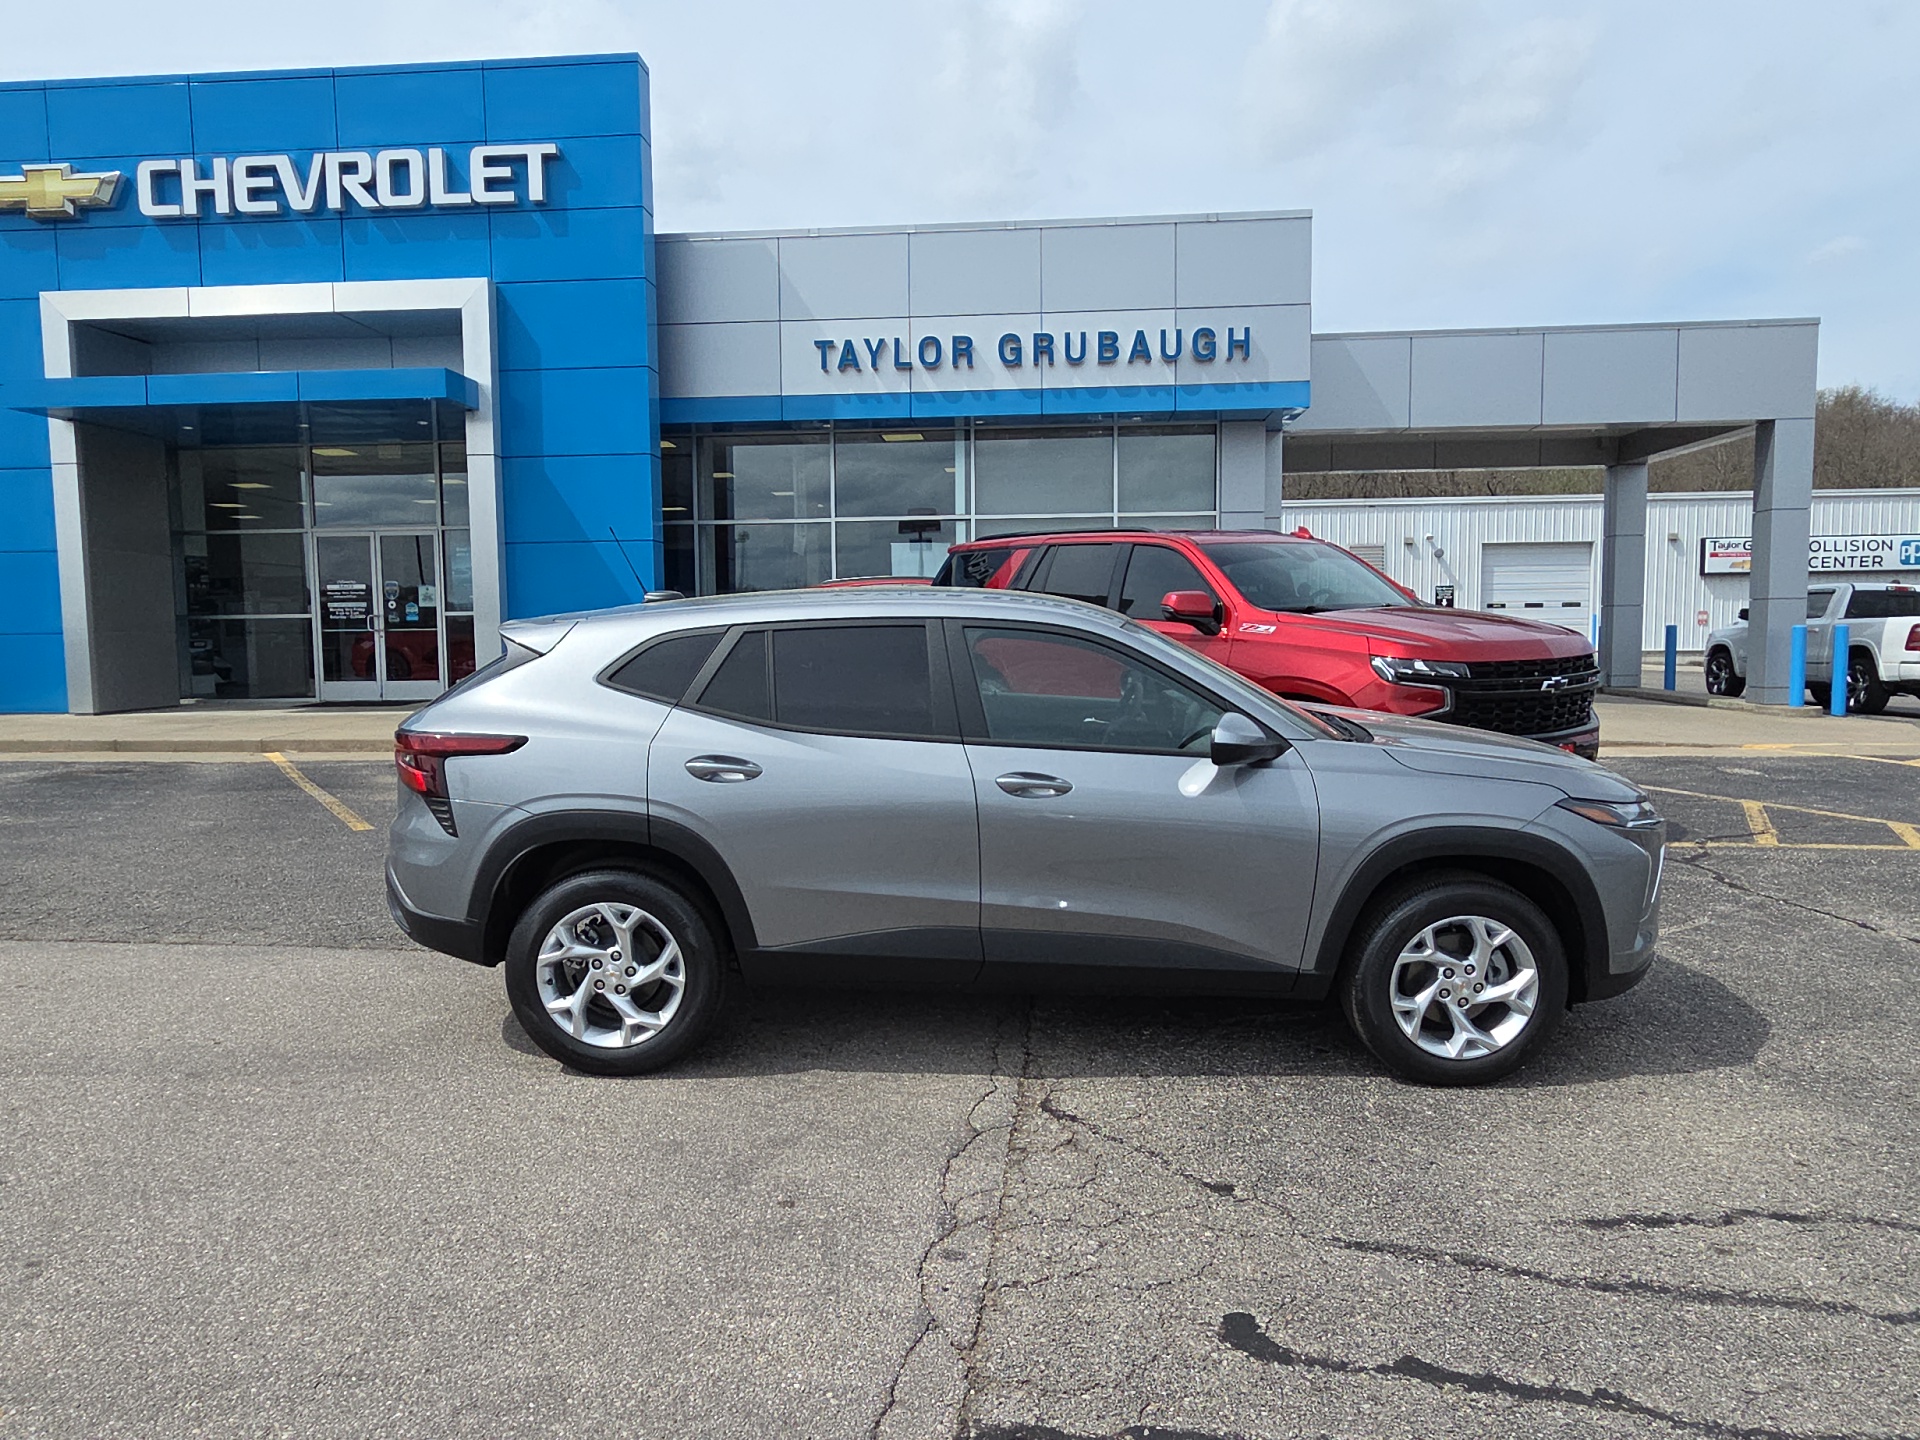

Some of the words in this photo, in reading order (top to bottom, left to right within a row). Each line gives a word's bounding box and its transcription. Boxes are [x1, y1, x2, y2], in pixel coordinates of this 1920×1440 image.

[137, 143, 559, 218] CHEVROLET
[814, 334, 974, 372] TAYLOR
[998, 326, 1252, 367] GRUBAUGH
[1710, 540, 1741, 551] Taylor
[1809, 539, 1893, 553] OLLISION
[1808, 555, 1883, 569] CENTER
